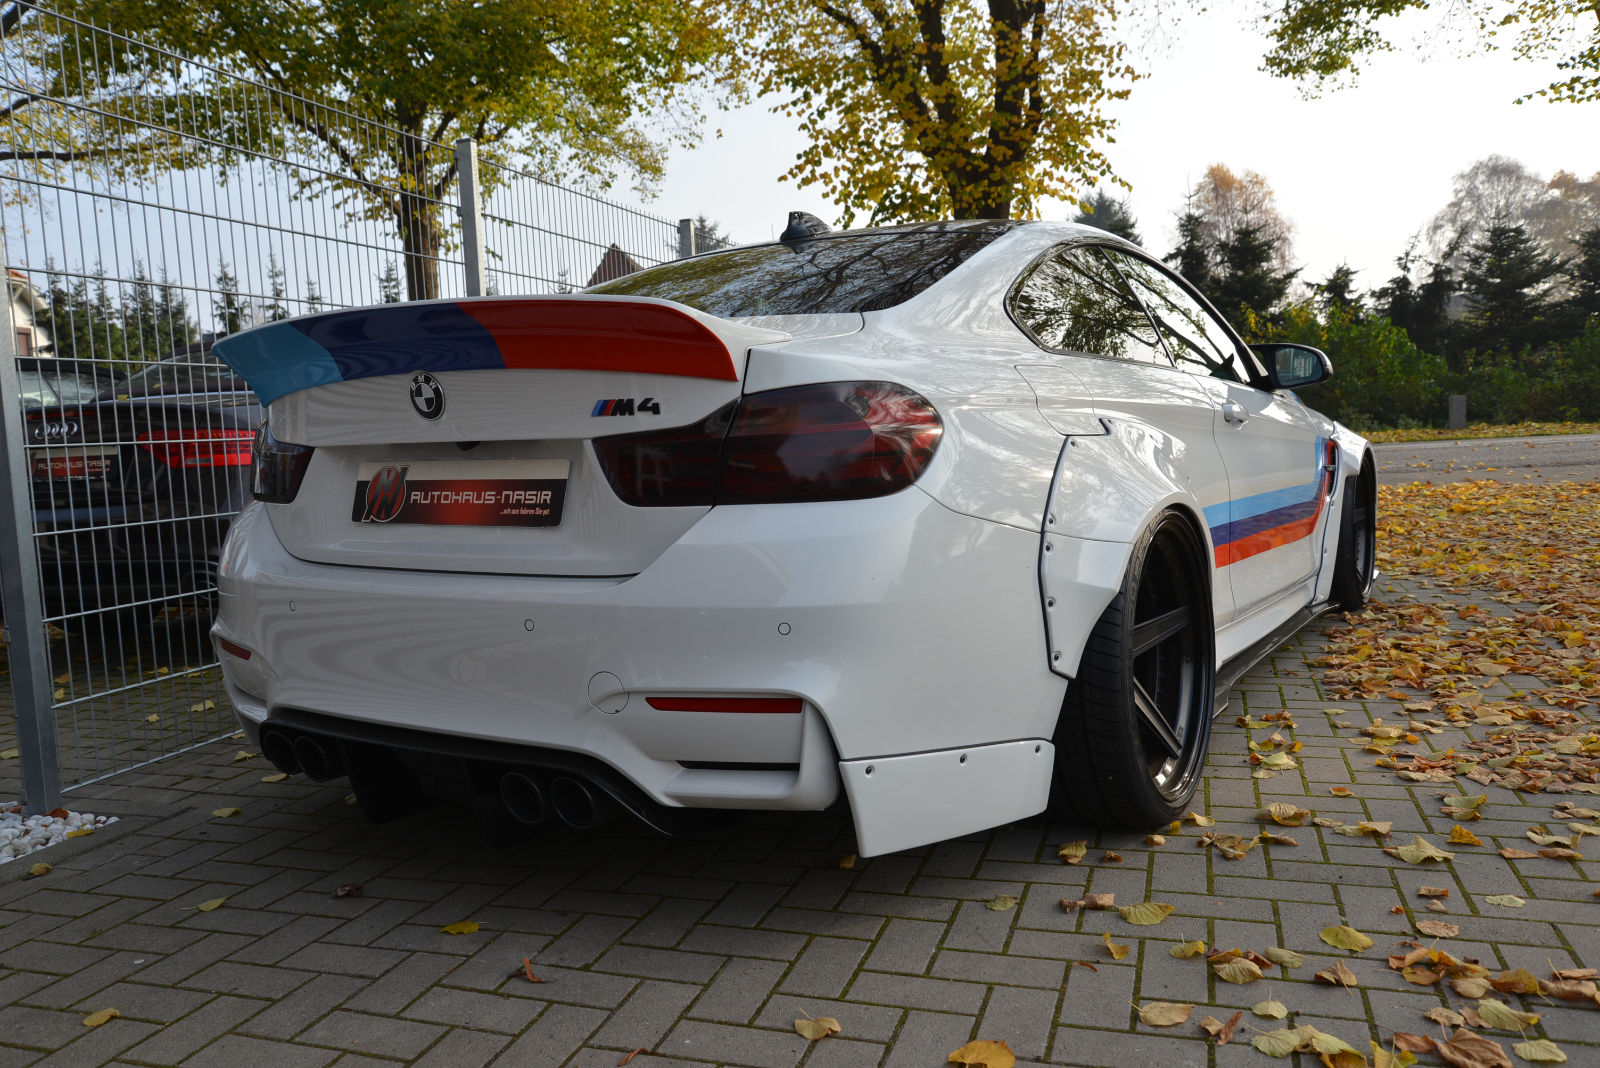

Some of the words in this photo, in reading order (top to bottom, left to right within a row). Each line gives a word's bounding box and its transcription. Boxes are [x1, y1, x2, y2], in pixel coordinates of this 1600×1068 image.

[410, 374, 437, 391] BMW
[609, 397, 661, 416] M4
[410, 490, 552, 504] AUTOHAUS-NASIR
